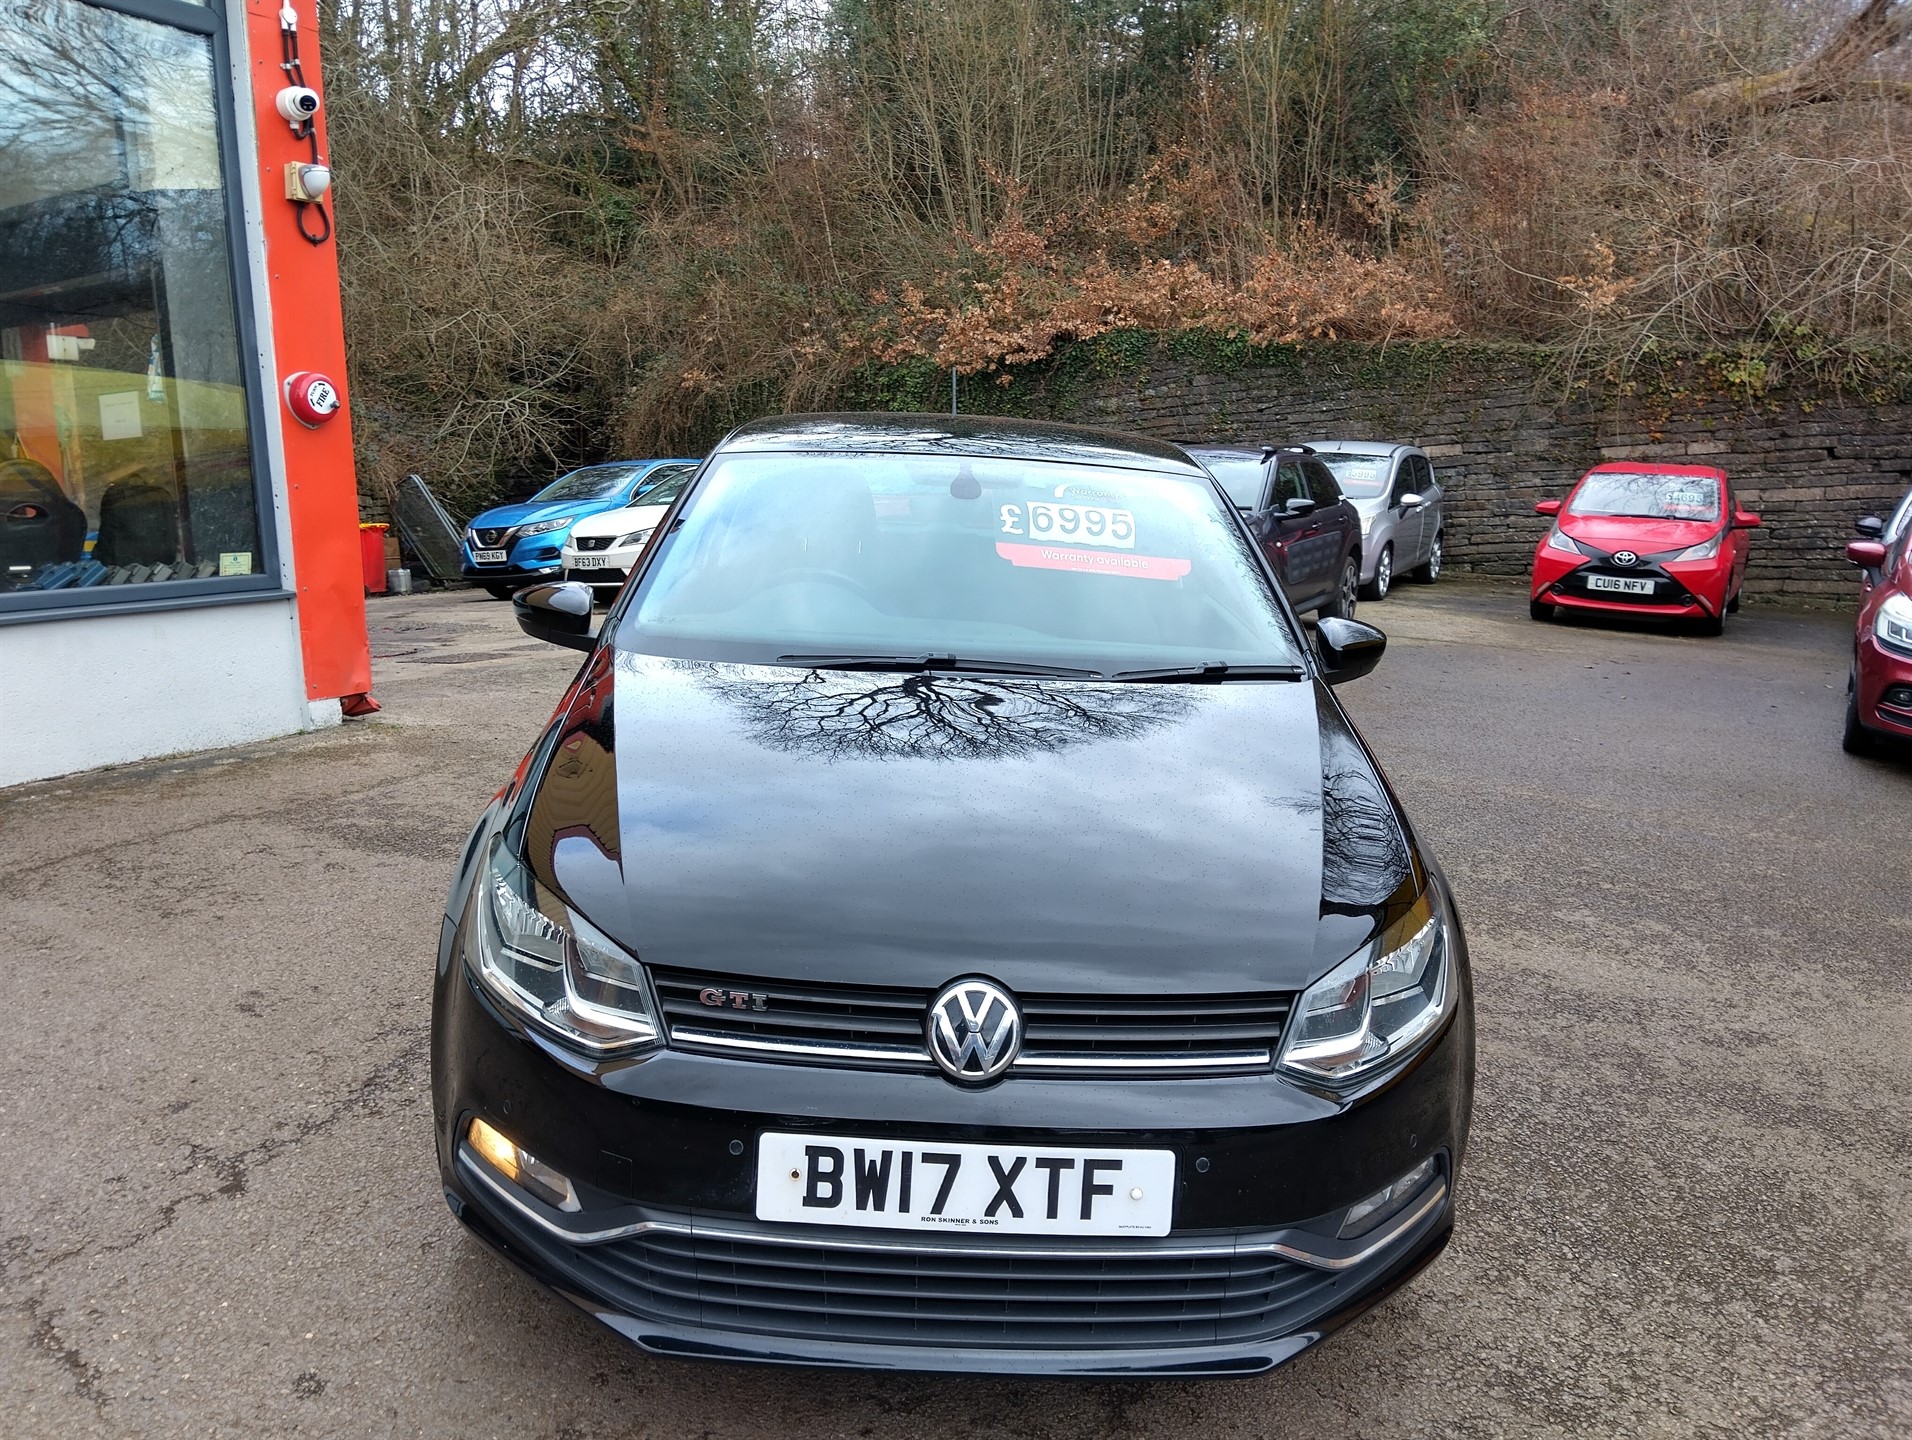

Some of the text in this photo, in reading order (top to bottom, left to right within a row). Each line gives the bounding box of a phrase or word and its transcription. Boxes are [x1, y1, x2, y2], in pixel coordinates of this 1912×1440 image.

[316, 387, 330, 407] FIRE
[475, 551, 504, 560] PN69 KGY
[574, 557, 607, 567] BF63 DXY
[1041, 549, 1149, 569] Warranty available
[1595, 578, 1647, 591] CU16 NFV
[700, 988, 769, 1012] GTI
[802, 1145, 1123, 1221] BW17 XTF
